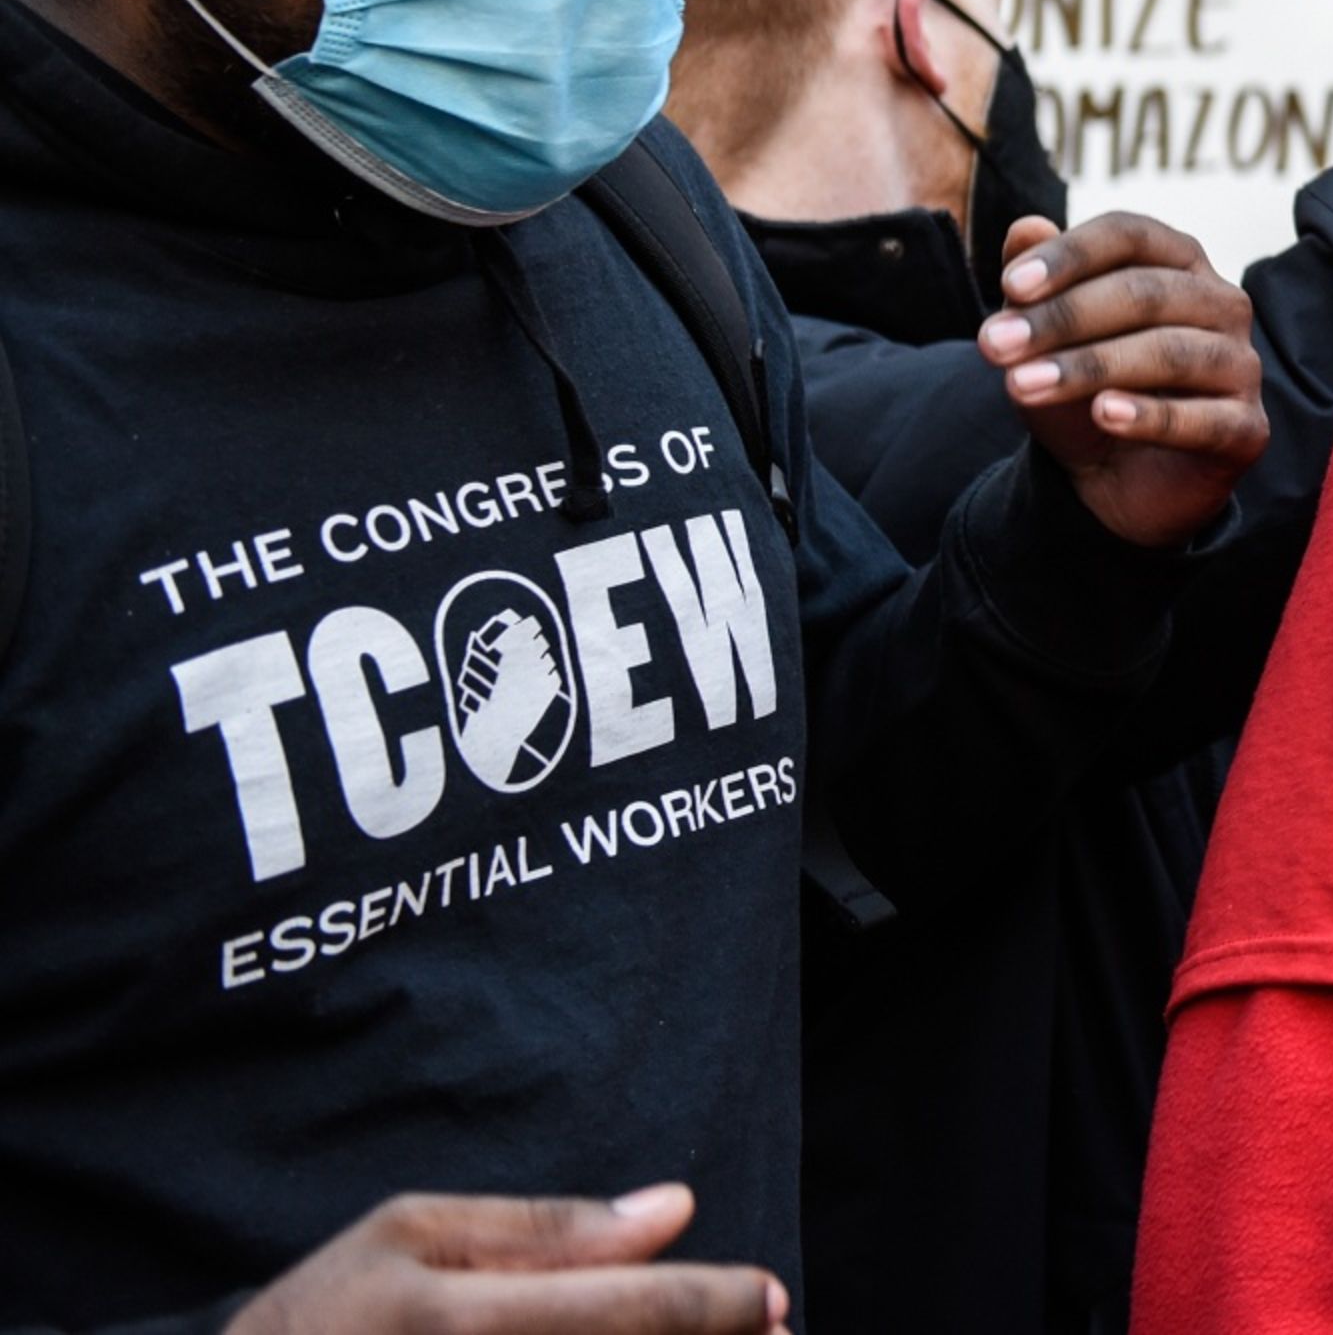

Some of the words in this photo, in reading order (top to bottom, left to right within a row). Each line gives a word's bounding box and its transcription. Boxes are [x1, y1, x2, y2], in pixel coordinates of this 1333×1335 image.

[139, 528, 305, 615] THE
[320, 443, 651, 564] CONGRES
[660, 426, 715, 475] OF
[222, 836, 553, 989] ESSENTIAL
[561, 757, 796, 865] WORKERS
